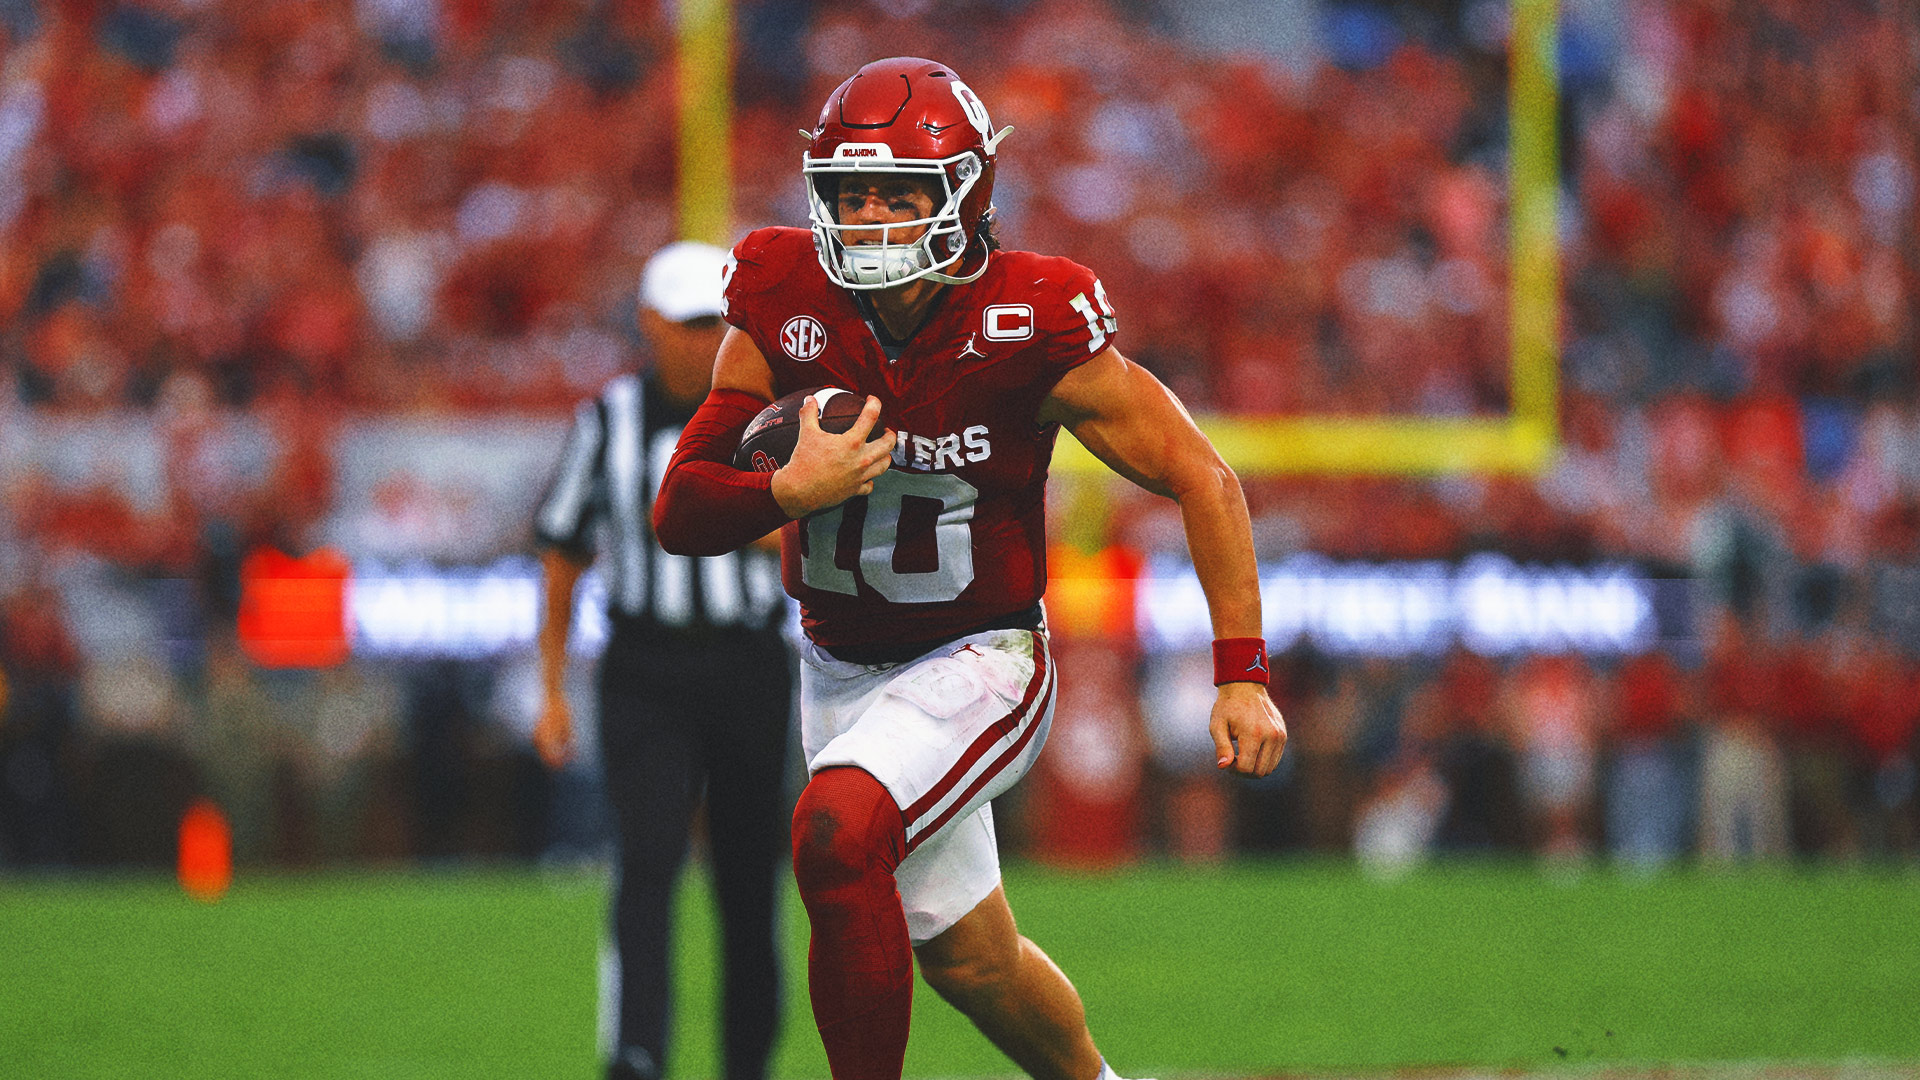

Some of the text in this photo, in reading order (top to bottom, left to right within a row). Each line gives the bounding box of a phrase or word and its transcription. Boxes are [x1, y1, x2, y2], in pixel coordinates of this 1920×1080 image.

[842, 148, 877, 157] OKLAHOMA
[784, 318, 823, 358] SEC
[986, 306, 1030, 338] C
[801, 469, 979, 603] 10
